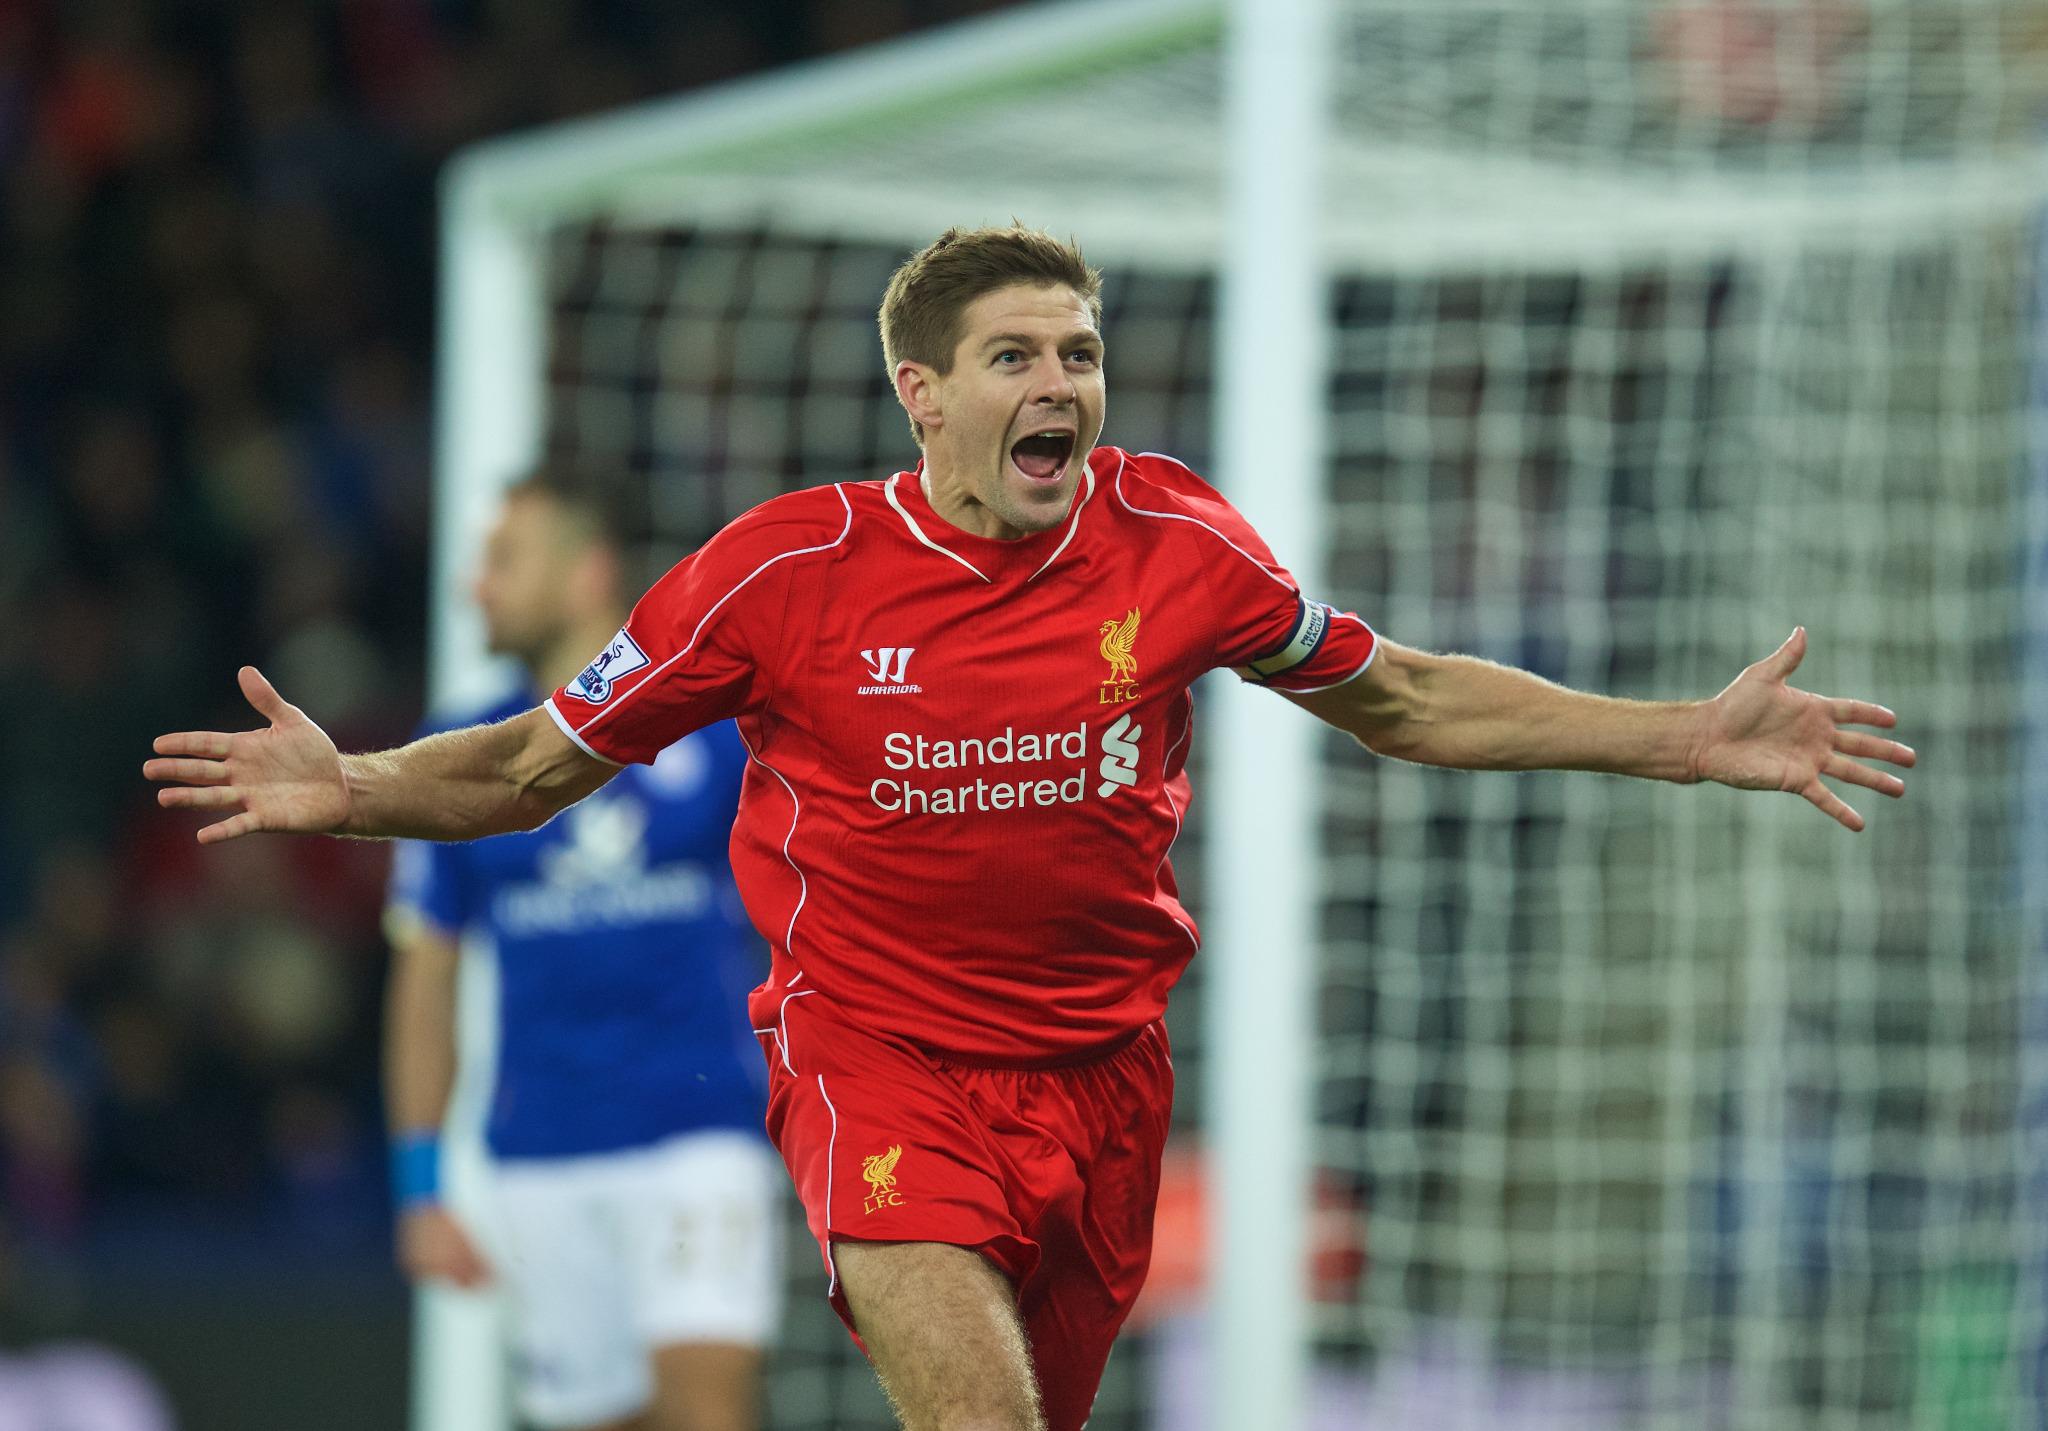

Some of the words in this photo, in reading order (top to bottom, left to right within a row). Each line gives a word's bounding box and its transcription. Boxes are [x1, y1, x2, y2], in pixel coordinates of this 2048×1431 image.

[1300, 611, 1317, 645] PREMIER
[1307, 616, 1323, 647] LEAGUE
[857, 684, 918, 695] WARRIOR
[884, 722, 1087, 771] Standard
[870, 768, 1086, 814] Chartered
